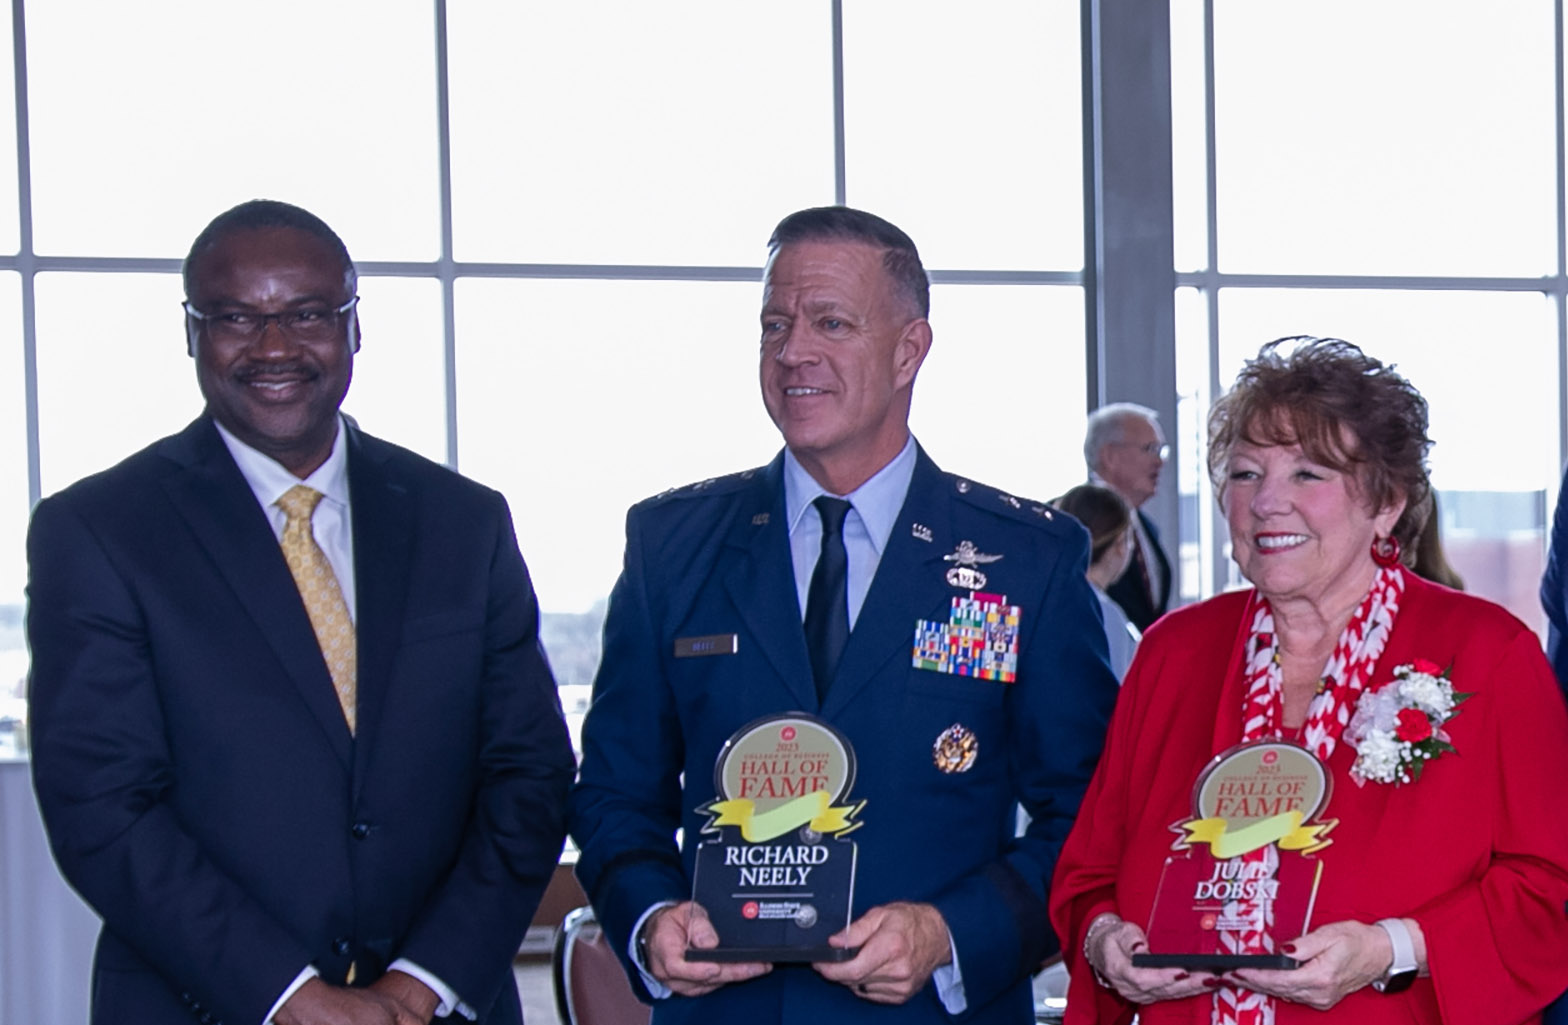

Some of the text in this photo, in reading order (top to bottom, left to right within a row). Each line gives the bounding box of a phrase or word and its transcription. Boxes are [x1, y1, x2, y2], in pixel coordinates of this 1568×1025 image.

[740, 759, 828, 775] HALL OF
[737, 776, 828, 799] FAME
[1218, 781, 1306, 796] HALL OF
[1213, 797, 1304, 818] FAME
[724, 845, 829, 865] RICHARD
[738, 866, 812, 886] NEELY
[1194, 880, 1281, 900] DOBSKI
